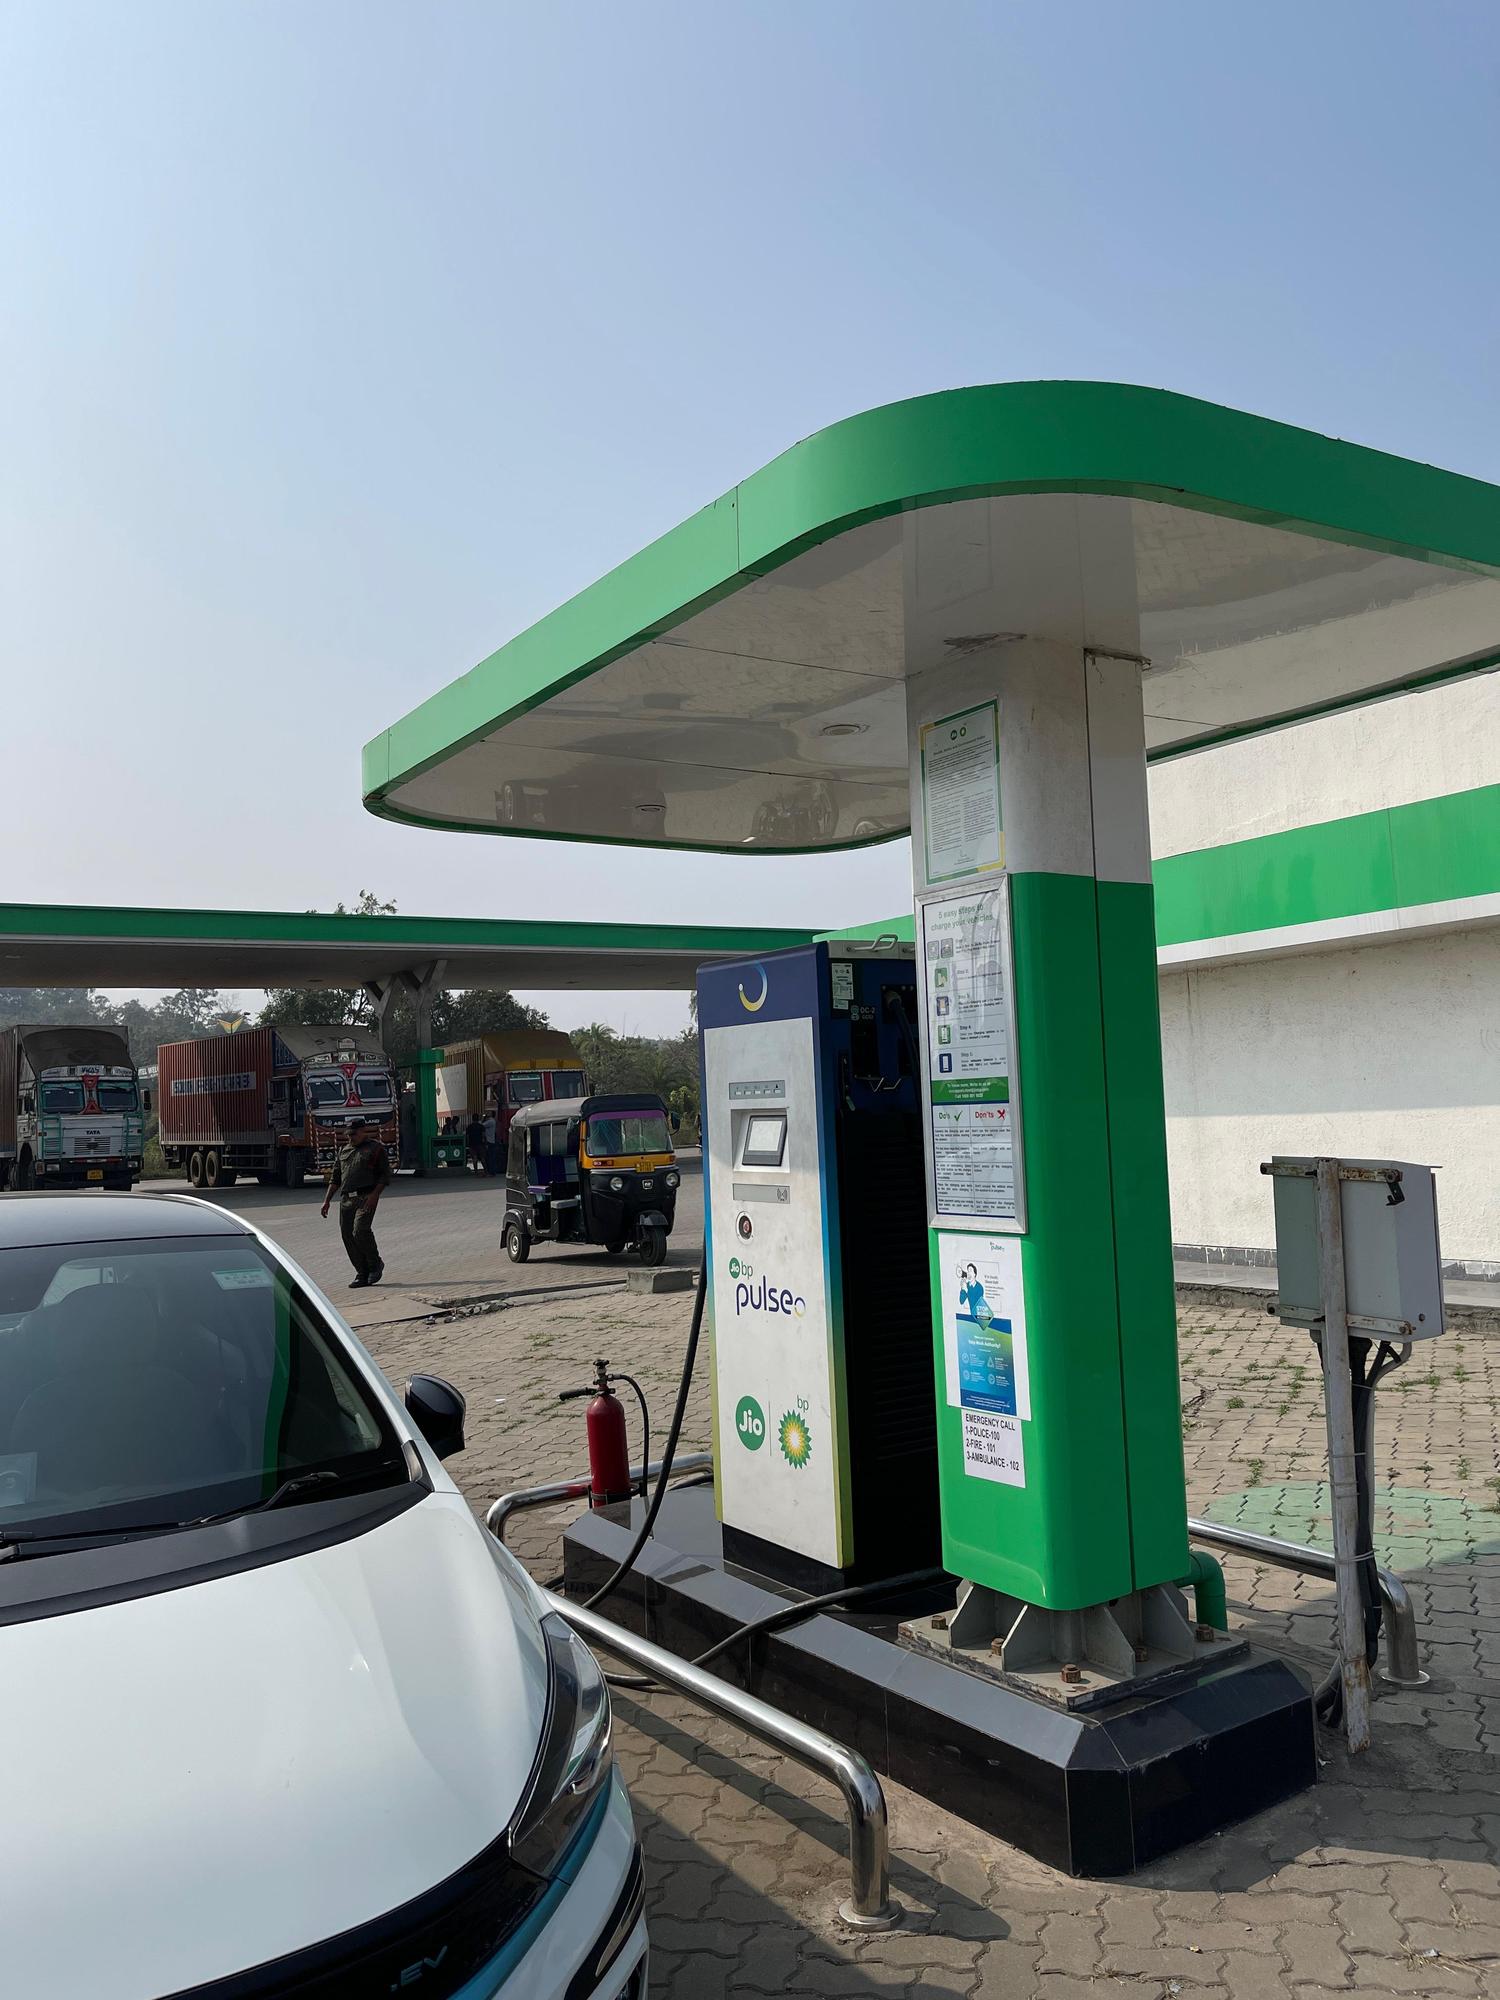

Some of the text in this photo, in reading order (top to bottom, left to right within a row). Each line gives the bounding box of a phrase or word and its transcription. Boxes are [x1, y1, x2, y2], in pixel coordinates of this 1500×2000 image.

[944, 909, 957, 918] easy
[958, 905, 975, 915] steps
[930, 914, 993, 931] charge your vehicles
[741, 1260, 754, 1280] bp
[736, 1275, 793, 1316] pulse
[739, 1394, 809, 1436] Jio bp
[965, 1413, 1015, 1431] EMERGENCY CALL
[965, 1426, 1000, 1441] 1-POLICE-100
[966, 1438, 983, 1450] 2-FIRE
[987, 1443, 996, 1453] 101
[966, 1451, 1006, 1468] 3-AMBULANCE
[1009, 1460, 1020, 1471] 102
